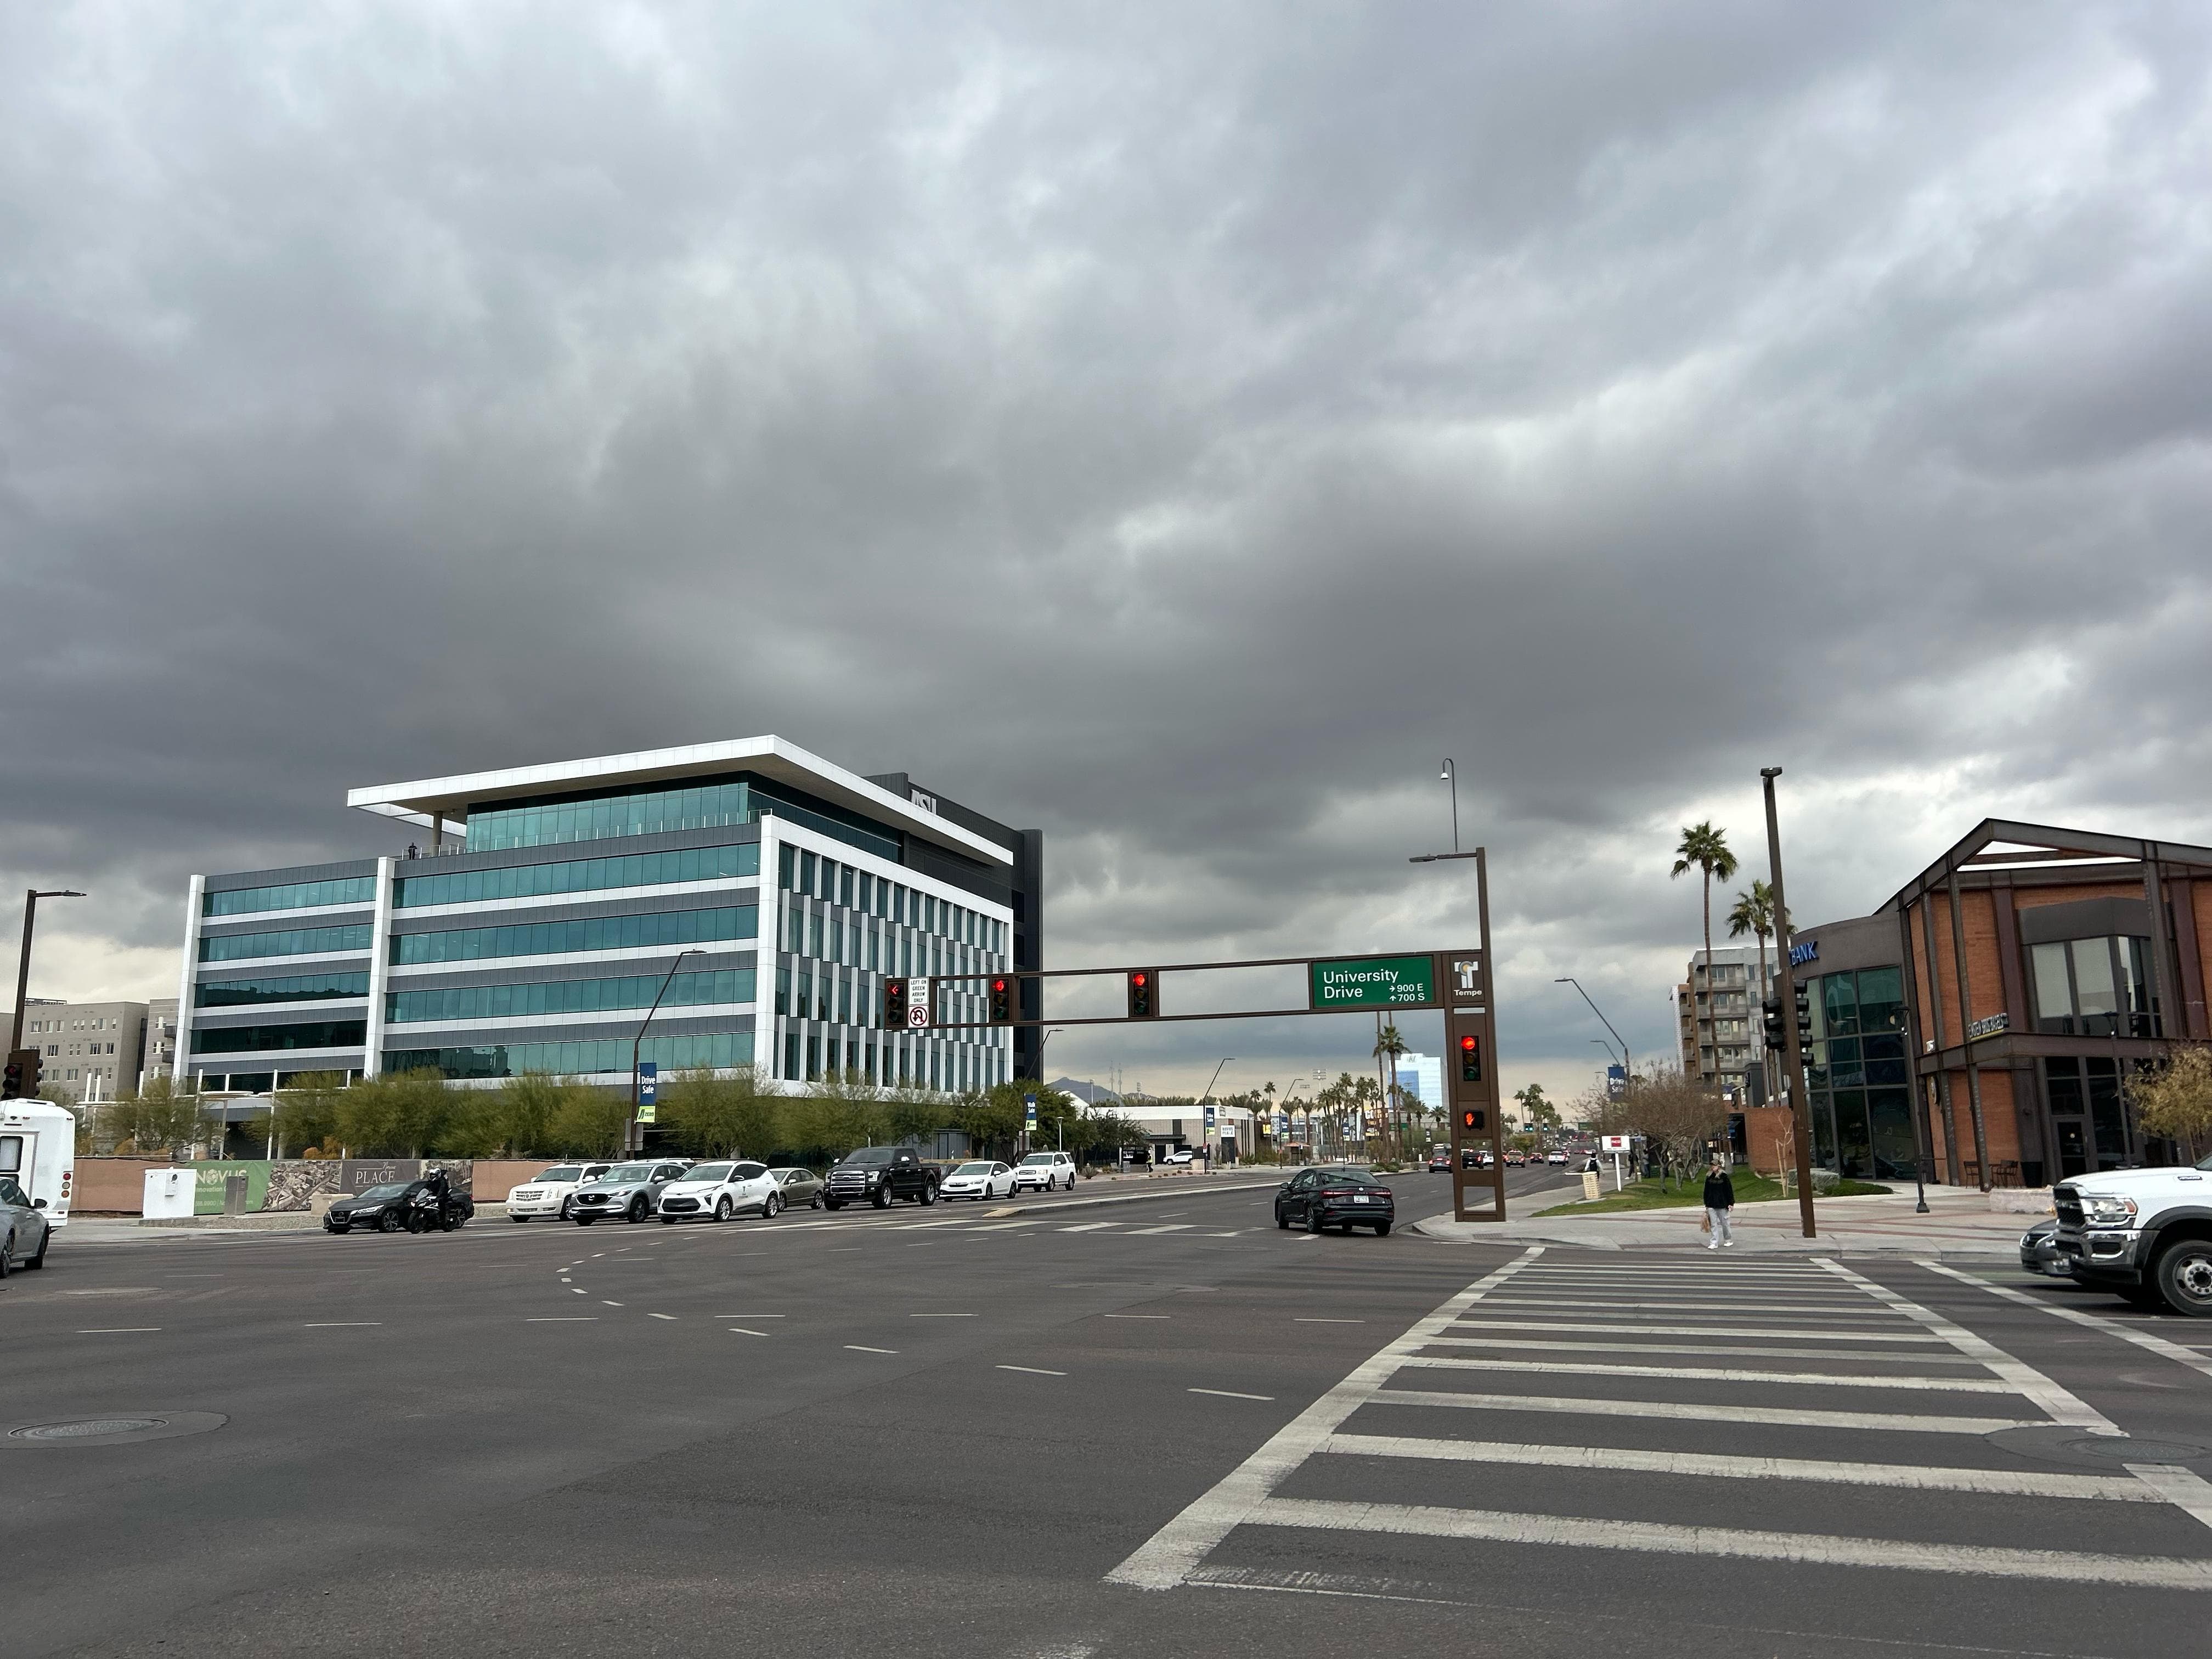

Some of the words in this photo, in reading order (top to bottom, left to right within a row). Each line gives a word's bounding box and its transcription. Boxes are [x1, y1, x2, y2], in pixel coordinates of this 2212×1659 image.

[1791, 941, 1817, 966] BANK
[1323, 969, 1399, 983] University
[1324, 985, 1363, 998] Drive
[1417, 983, 1424, 991] E
[1398, 994, 1415, 1002] 700
[1418, 992, 1425, 1001] S
[641, 1076, 656, 1085] Drive
[642, 1085, 654, 1094] Safe
[355, 1171, 395, 1183] PLACE
